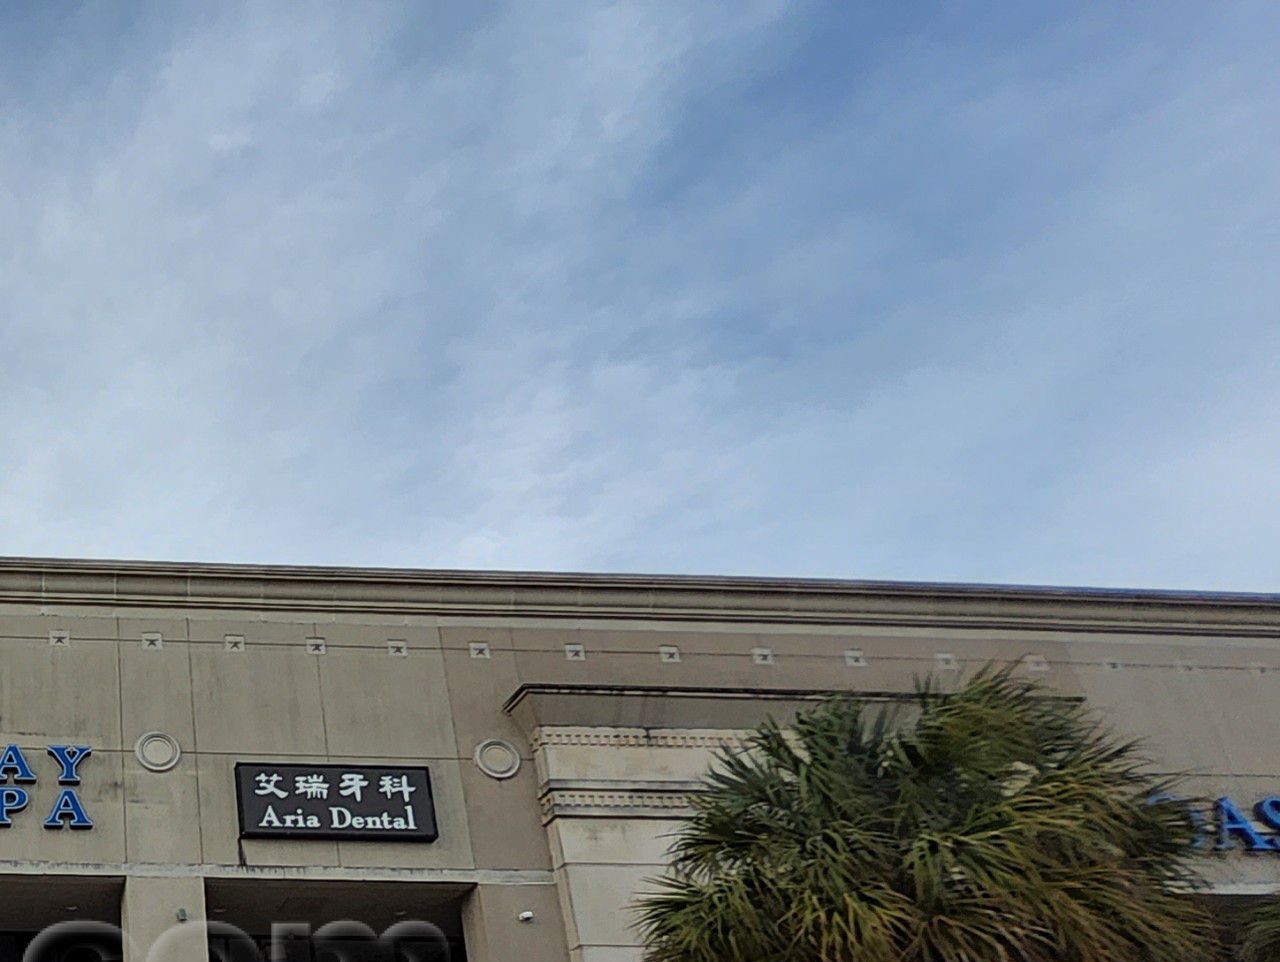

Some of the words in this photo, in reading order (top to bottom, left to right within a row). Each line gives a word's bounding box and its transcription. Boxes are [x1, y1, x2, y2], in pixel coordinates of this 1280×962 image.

[254, 772, 417, 802] 艾瑞牙科
[258, 805, 321, 828] Aria
[328, 805, 418, 830] Dental
